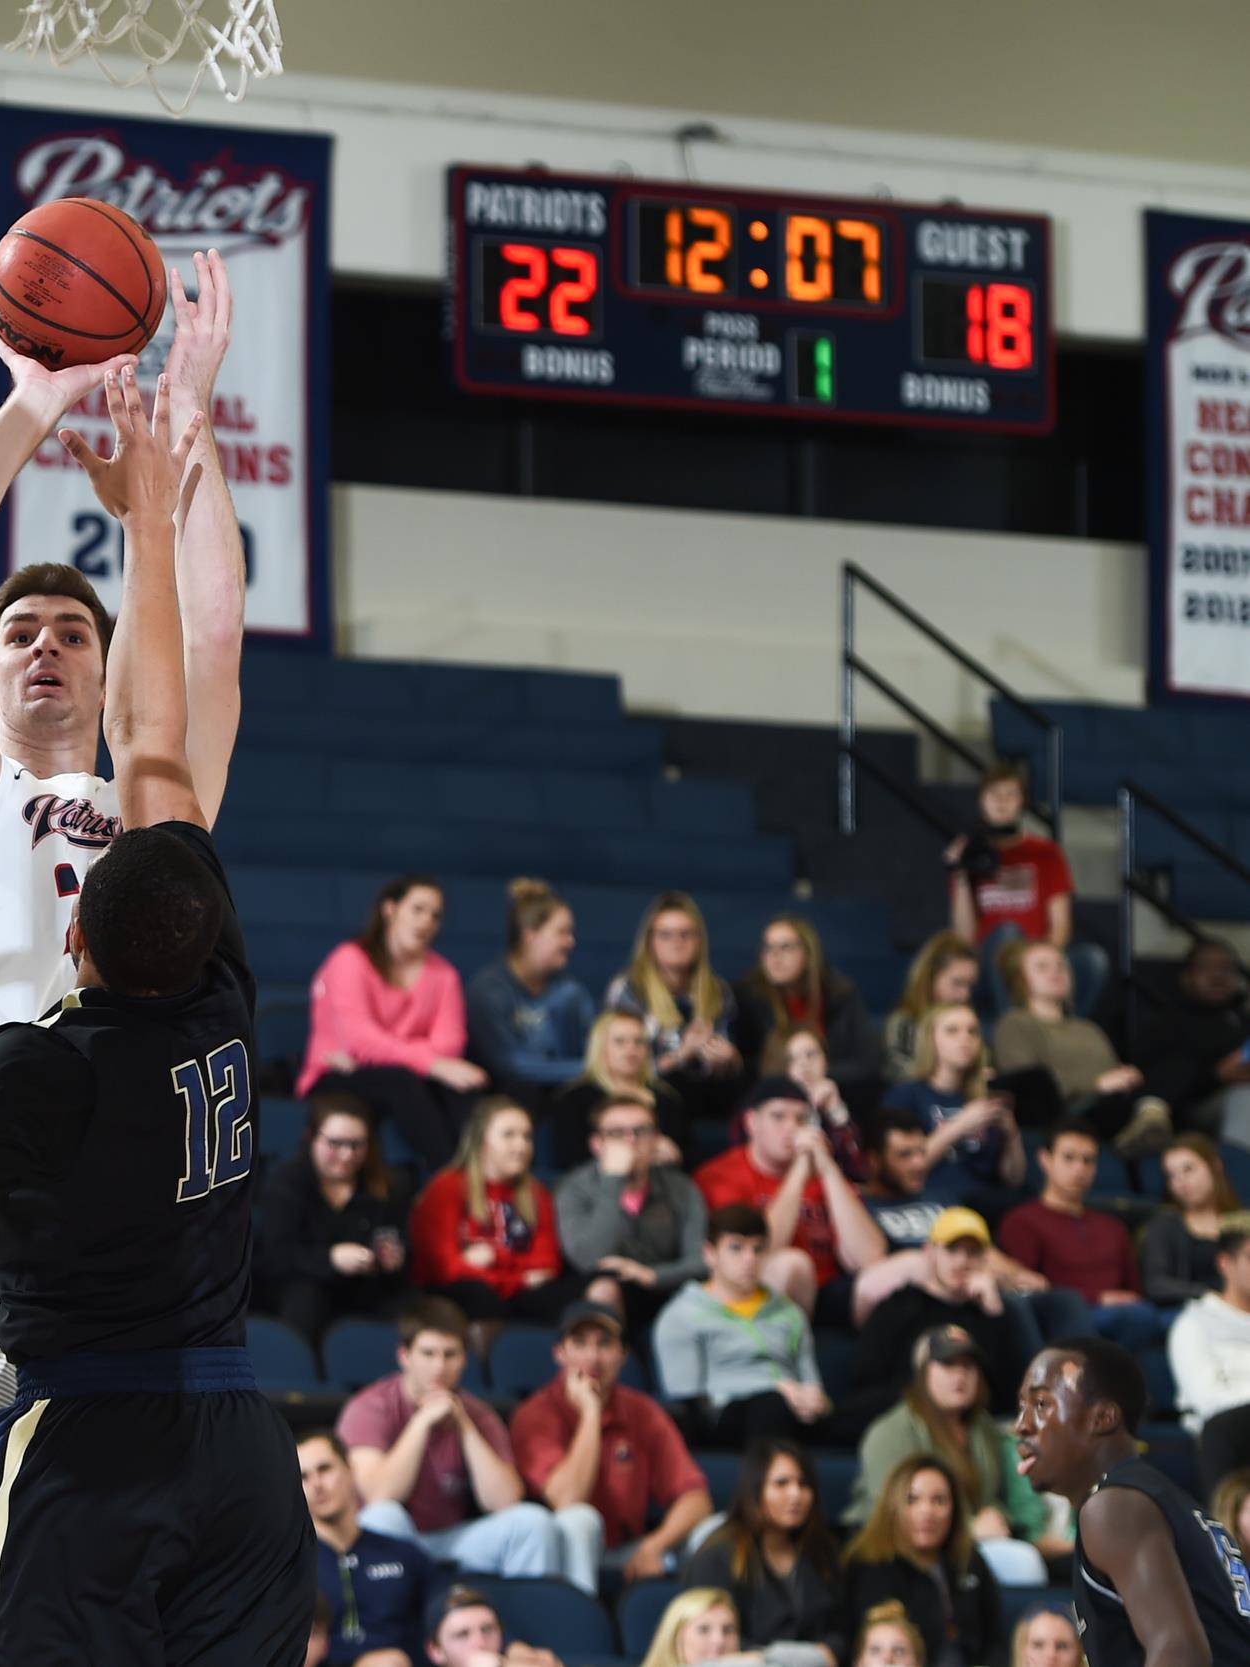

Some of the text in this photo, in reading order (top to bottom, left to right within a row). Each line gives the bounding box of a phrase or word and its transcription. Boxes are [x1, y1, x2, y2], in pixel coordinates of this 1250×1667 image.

[466, 182, 606, 236] PATRIOTS
[664, 207, 882, 305] 12:07
[917, 220, 1030, 269] GUEST
[498, 242, 598, 336] 22
[966, 282, 1034, 370] 18
[522, 343, 614, 384] BONUS
[682, 335, 782, 377] PERIOD
[813, 336, 833, 403] 1
[901, 371, 991, 413] BONUS
[22, 793, 124, 849] Patrio
[170, 1038, 253, 1203] 12
